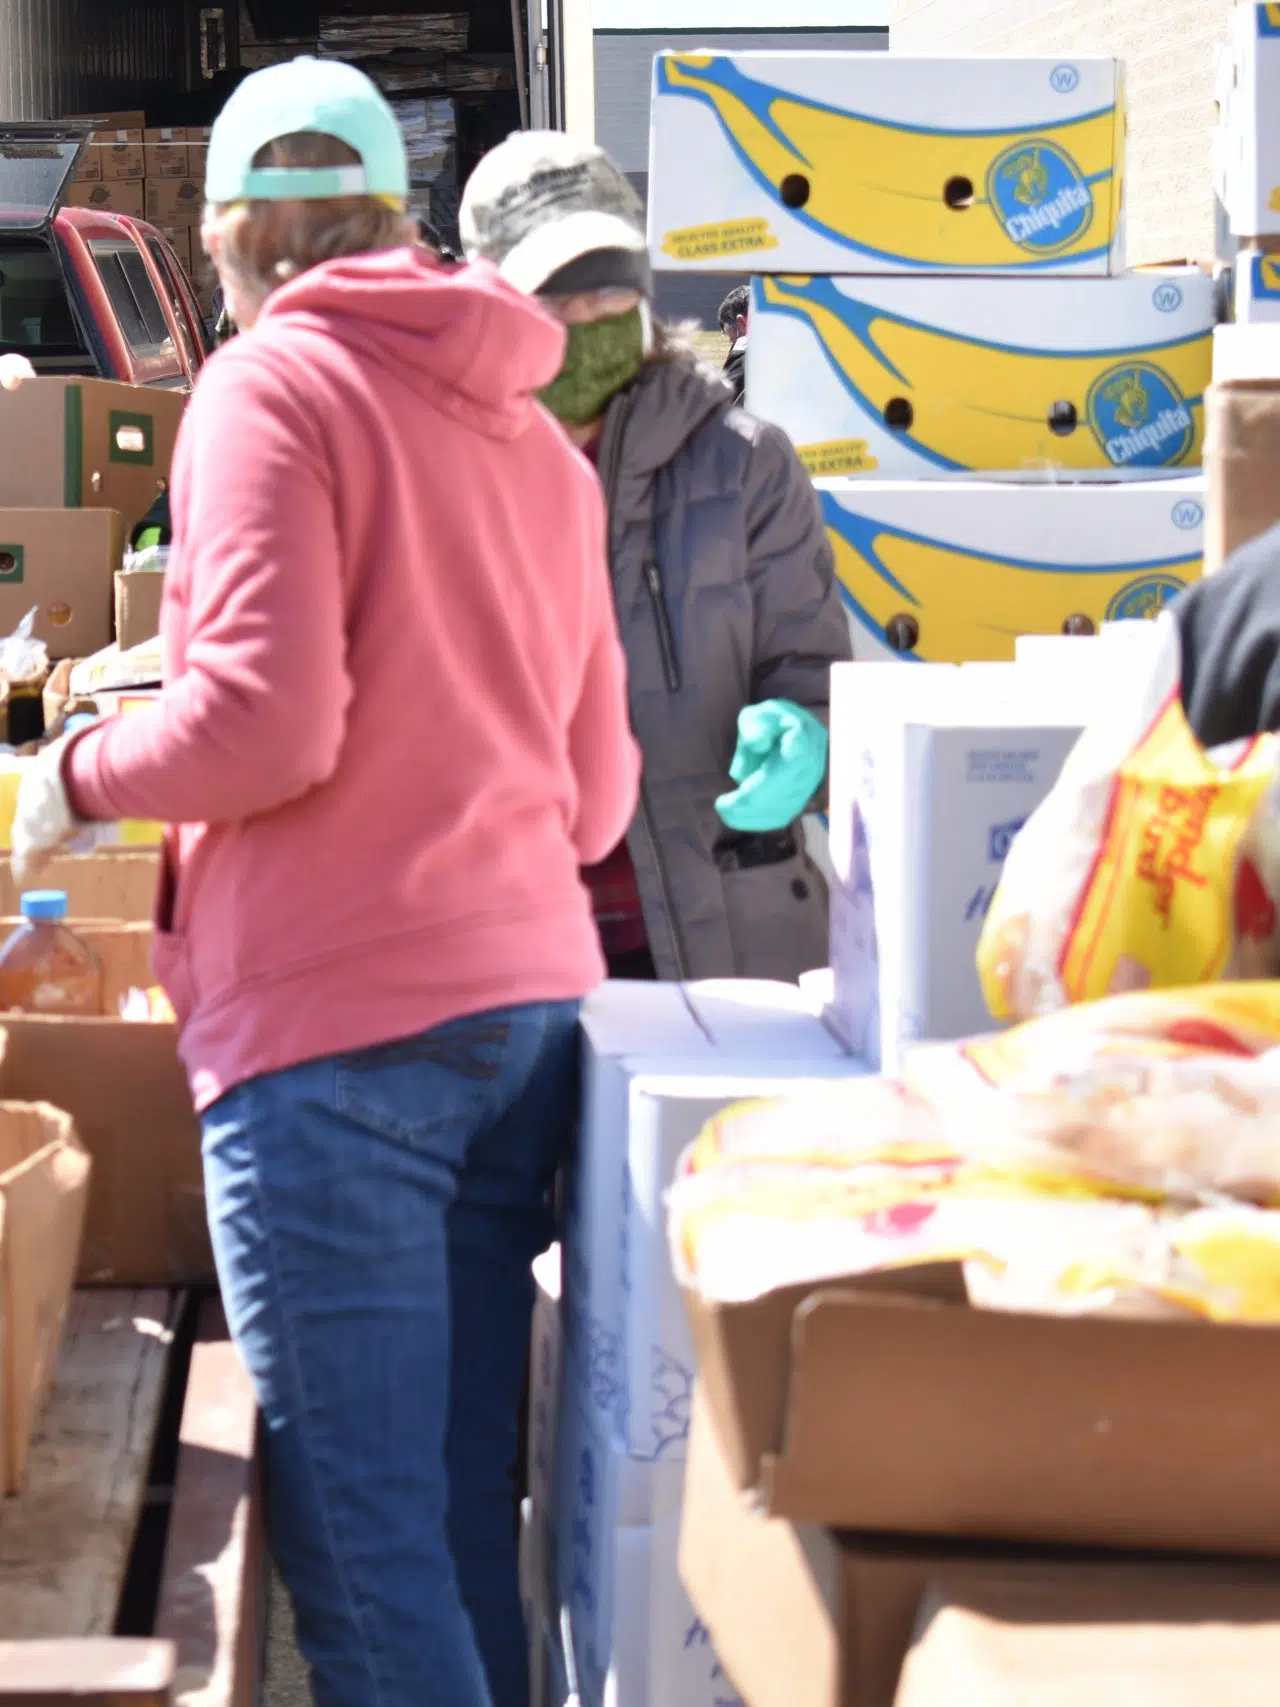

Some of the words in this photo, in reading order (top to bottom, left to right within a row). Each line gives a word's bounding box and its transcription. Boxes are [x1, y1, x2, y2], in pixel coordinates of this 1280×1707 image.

[1005, 181, 1090, 242] Chiquita
[720, 236, 765, 251] EXTRA
[1105, 403, 1191, 463] Chiquita
